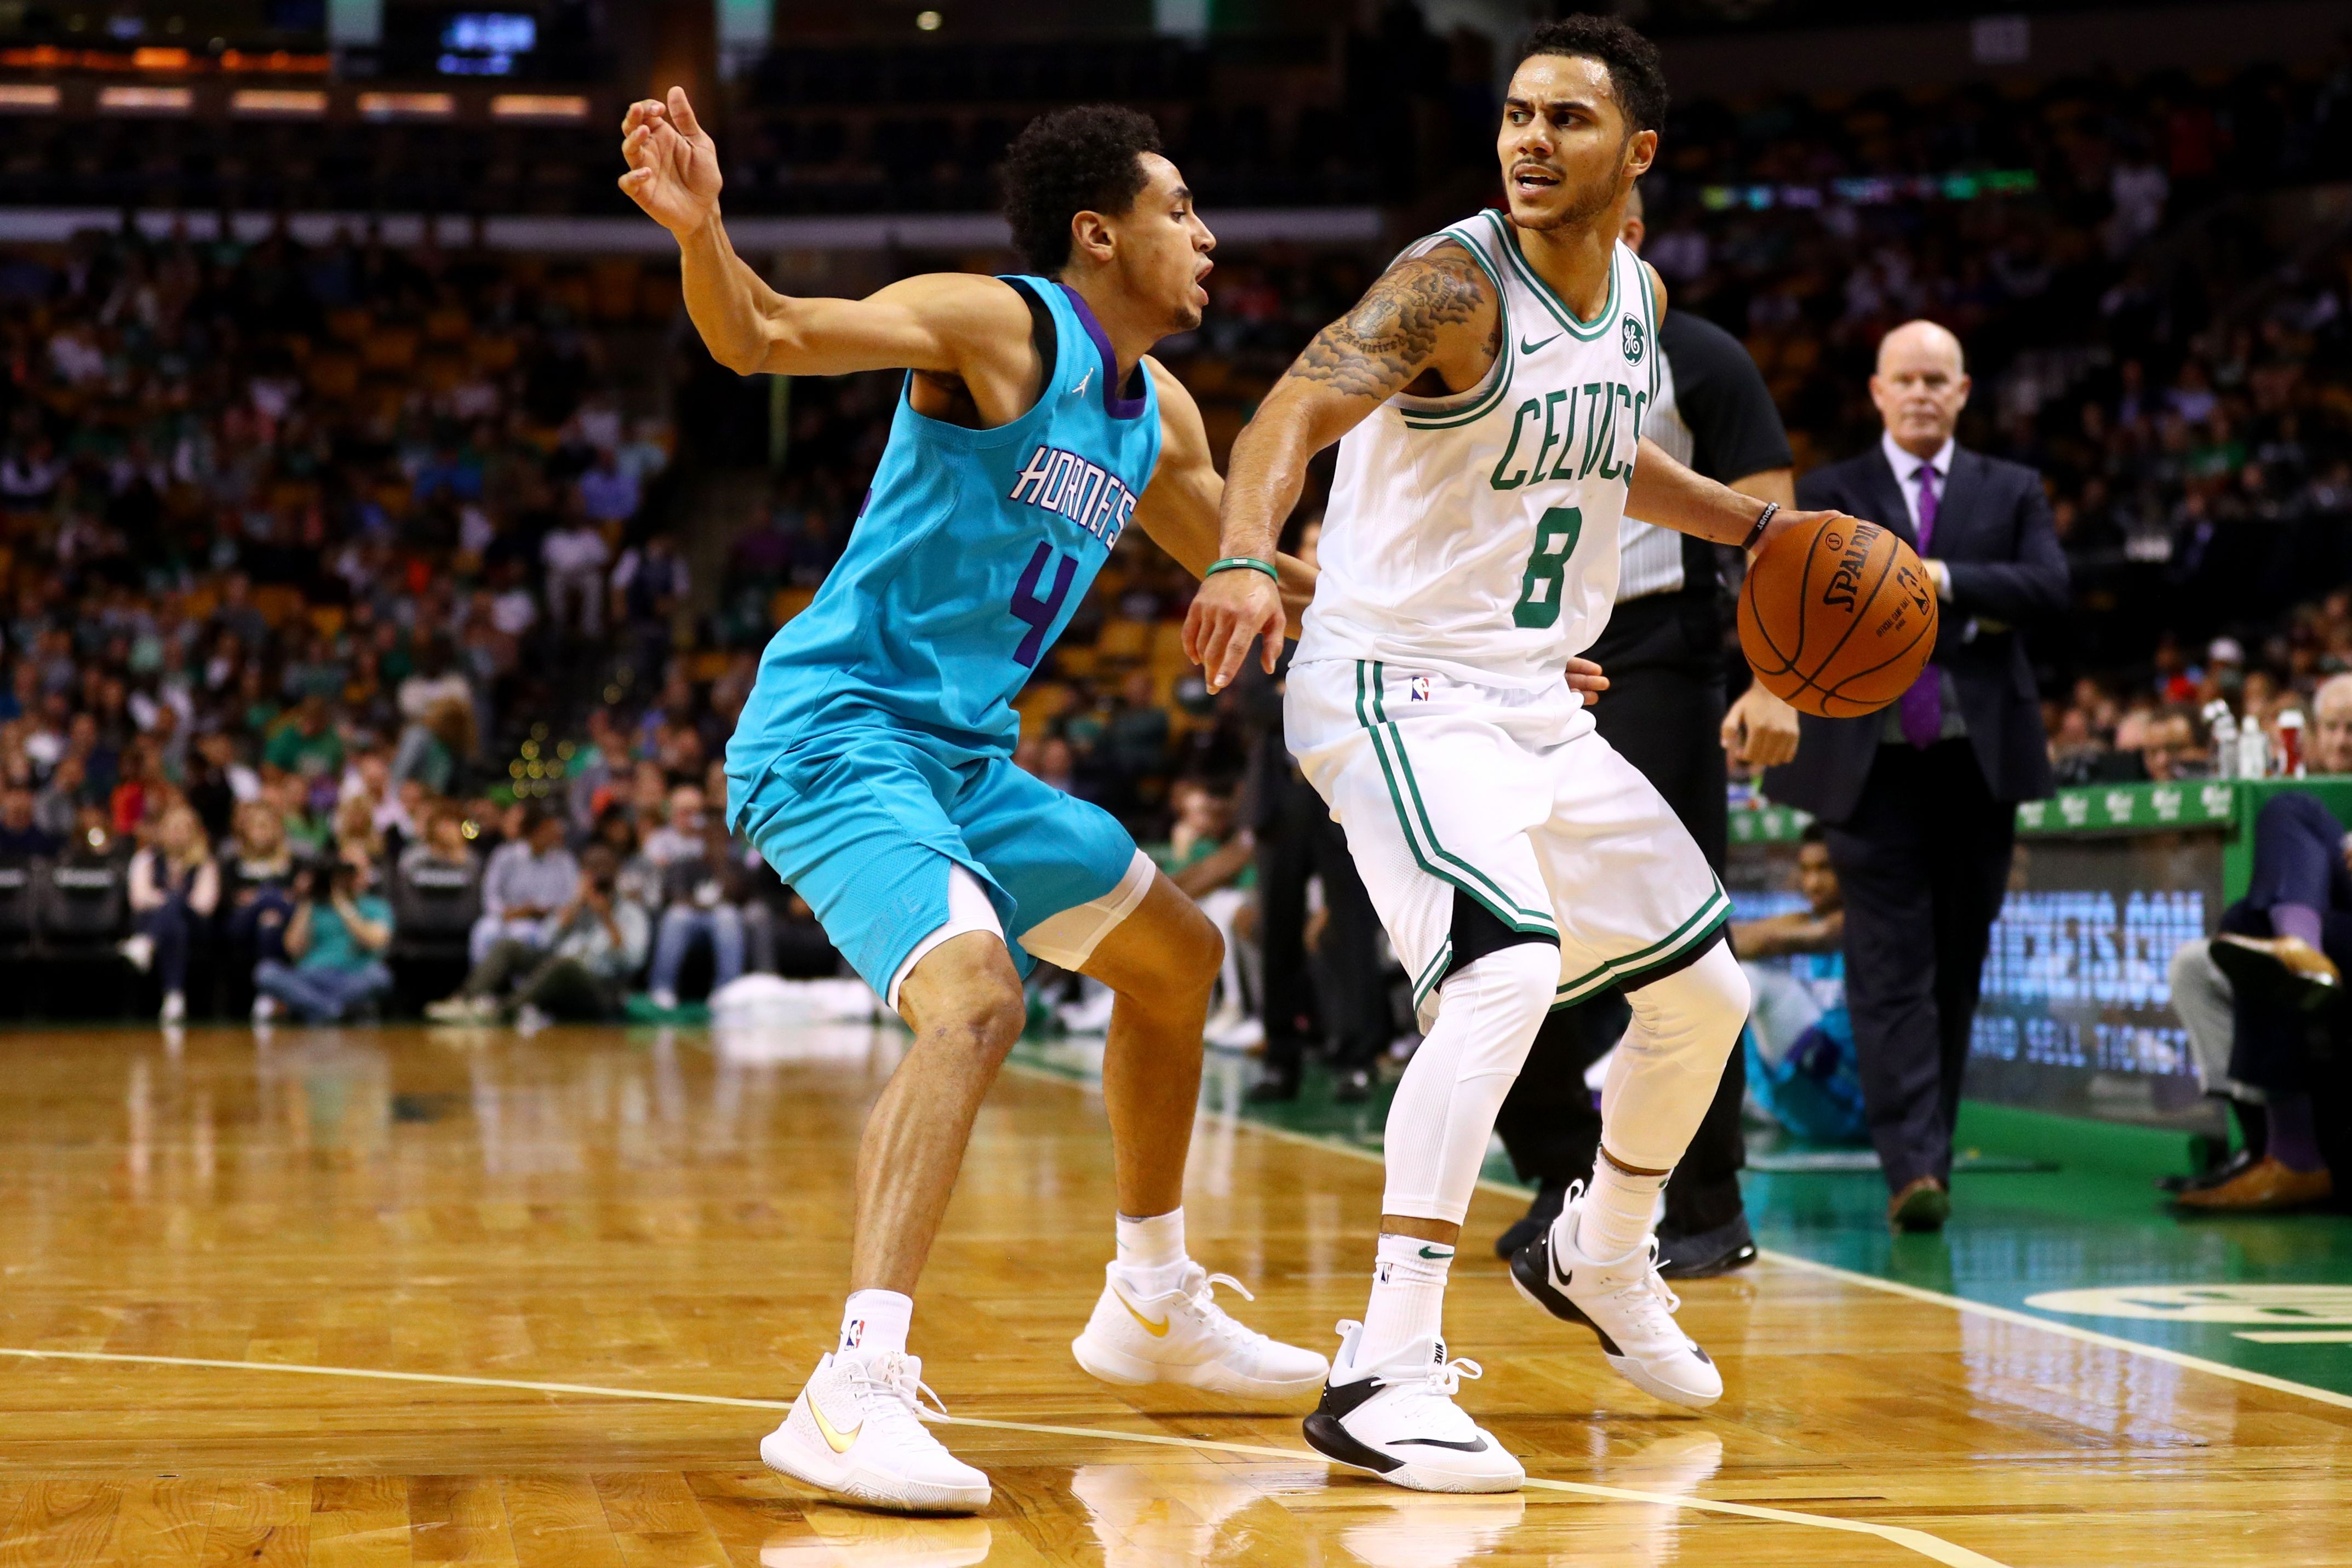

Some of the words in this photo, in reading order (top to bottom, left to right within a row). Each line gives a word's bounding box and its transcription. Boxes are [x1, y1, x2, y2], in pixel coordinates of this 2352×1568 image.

[1490, 381, 1646, 490] CELTICS
[1008, 445, 1139, 552] HORNETS
[1010, 539, 1079, 669] 4
[1512, 506, 1583, 629] 8
[1823, 520, 1882, 613] SPALDIN
[1434, 1342, 1444, 1366] NIKE
